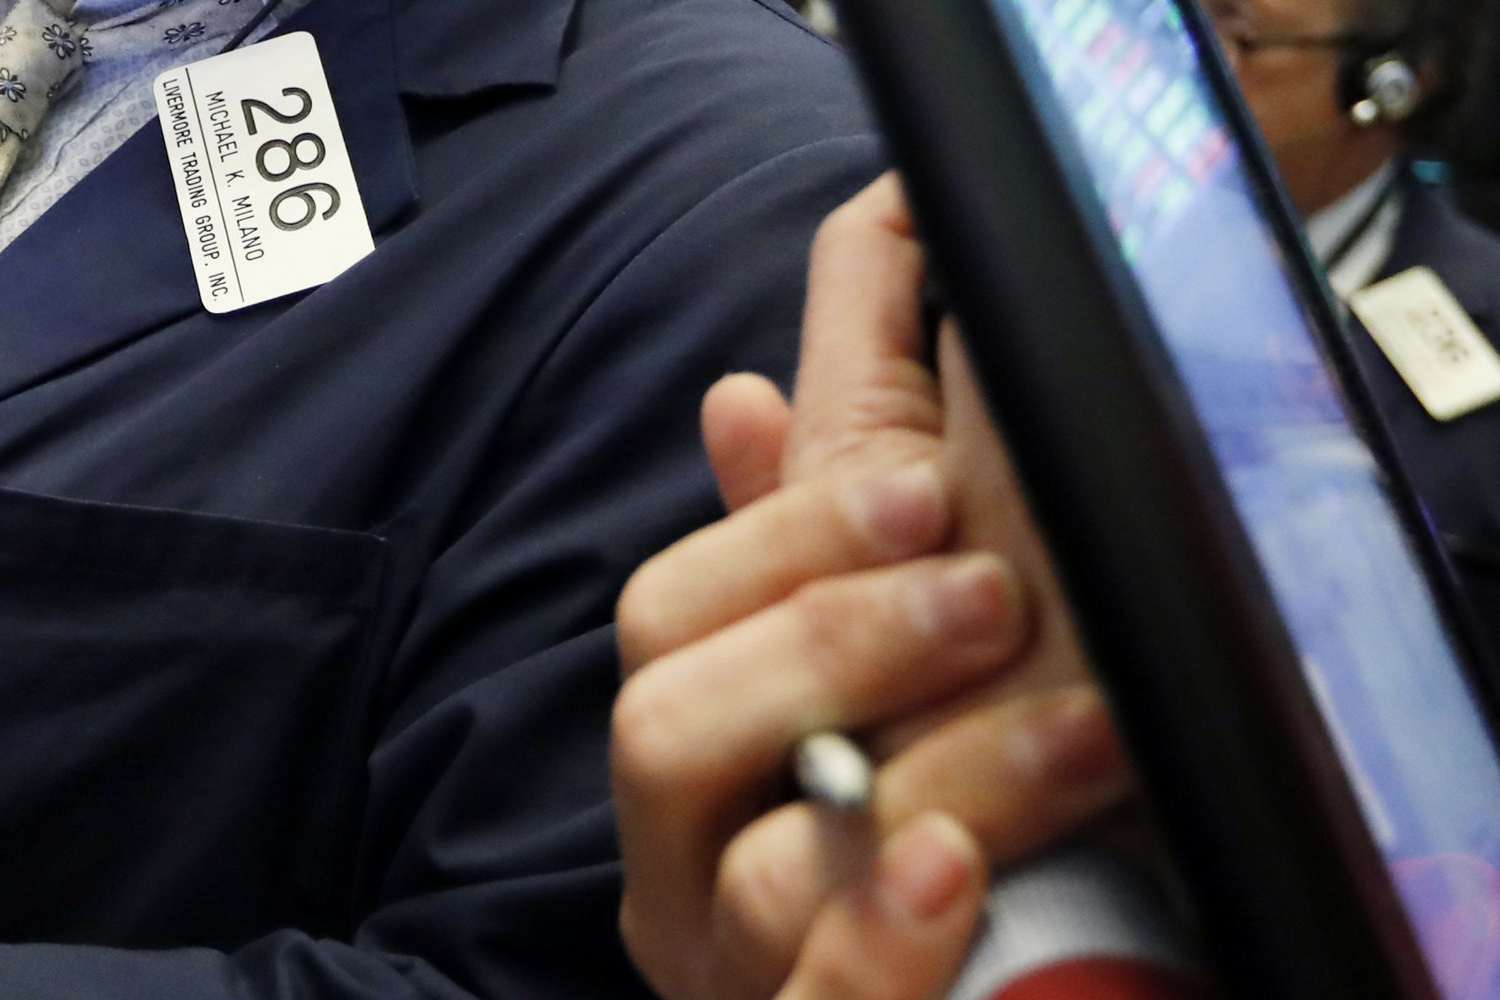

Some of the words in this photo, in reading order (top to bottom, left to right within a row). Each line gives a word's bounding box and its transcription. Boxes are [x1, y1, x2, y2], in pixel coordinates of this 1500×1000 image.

[205, 90, 238, 163] MICHAEL
[240, 86, 341, 231] 286
[162, 78, 194, 148] LIVERMORE
[180, 151, 208, 209] TRADING
[208, 272, 229, 301] INC.
[225, 169, 245, 187] K.
[231, 195, 265, 261] MILANO
